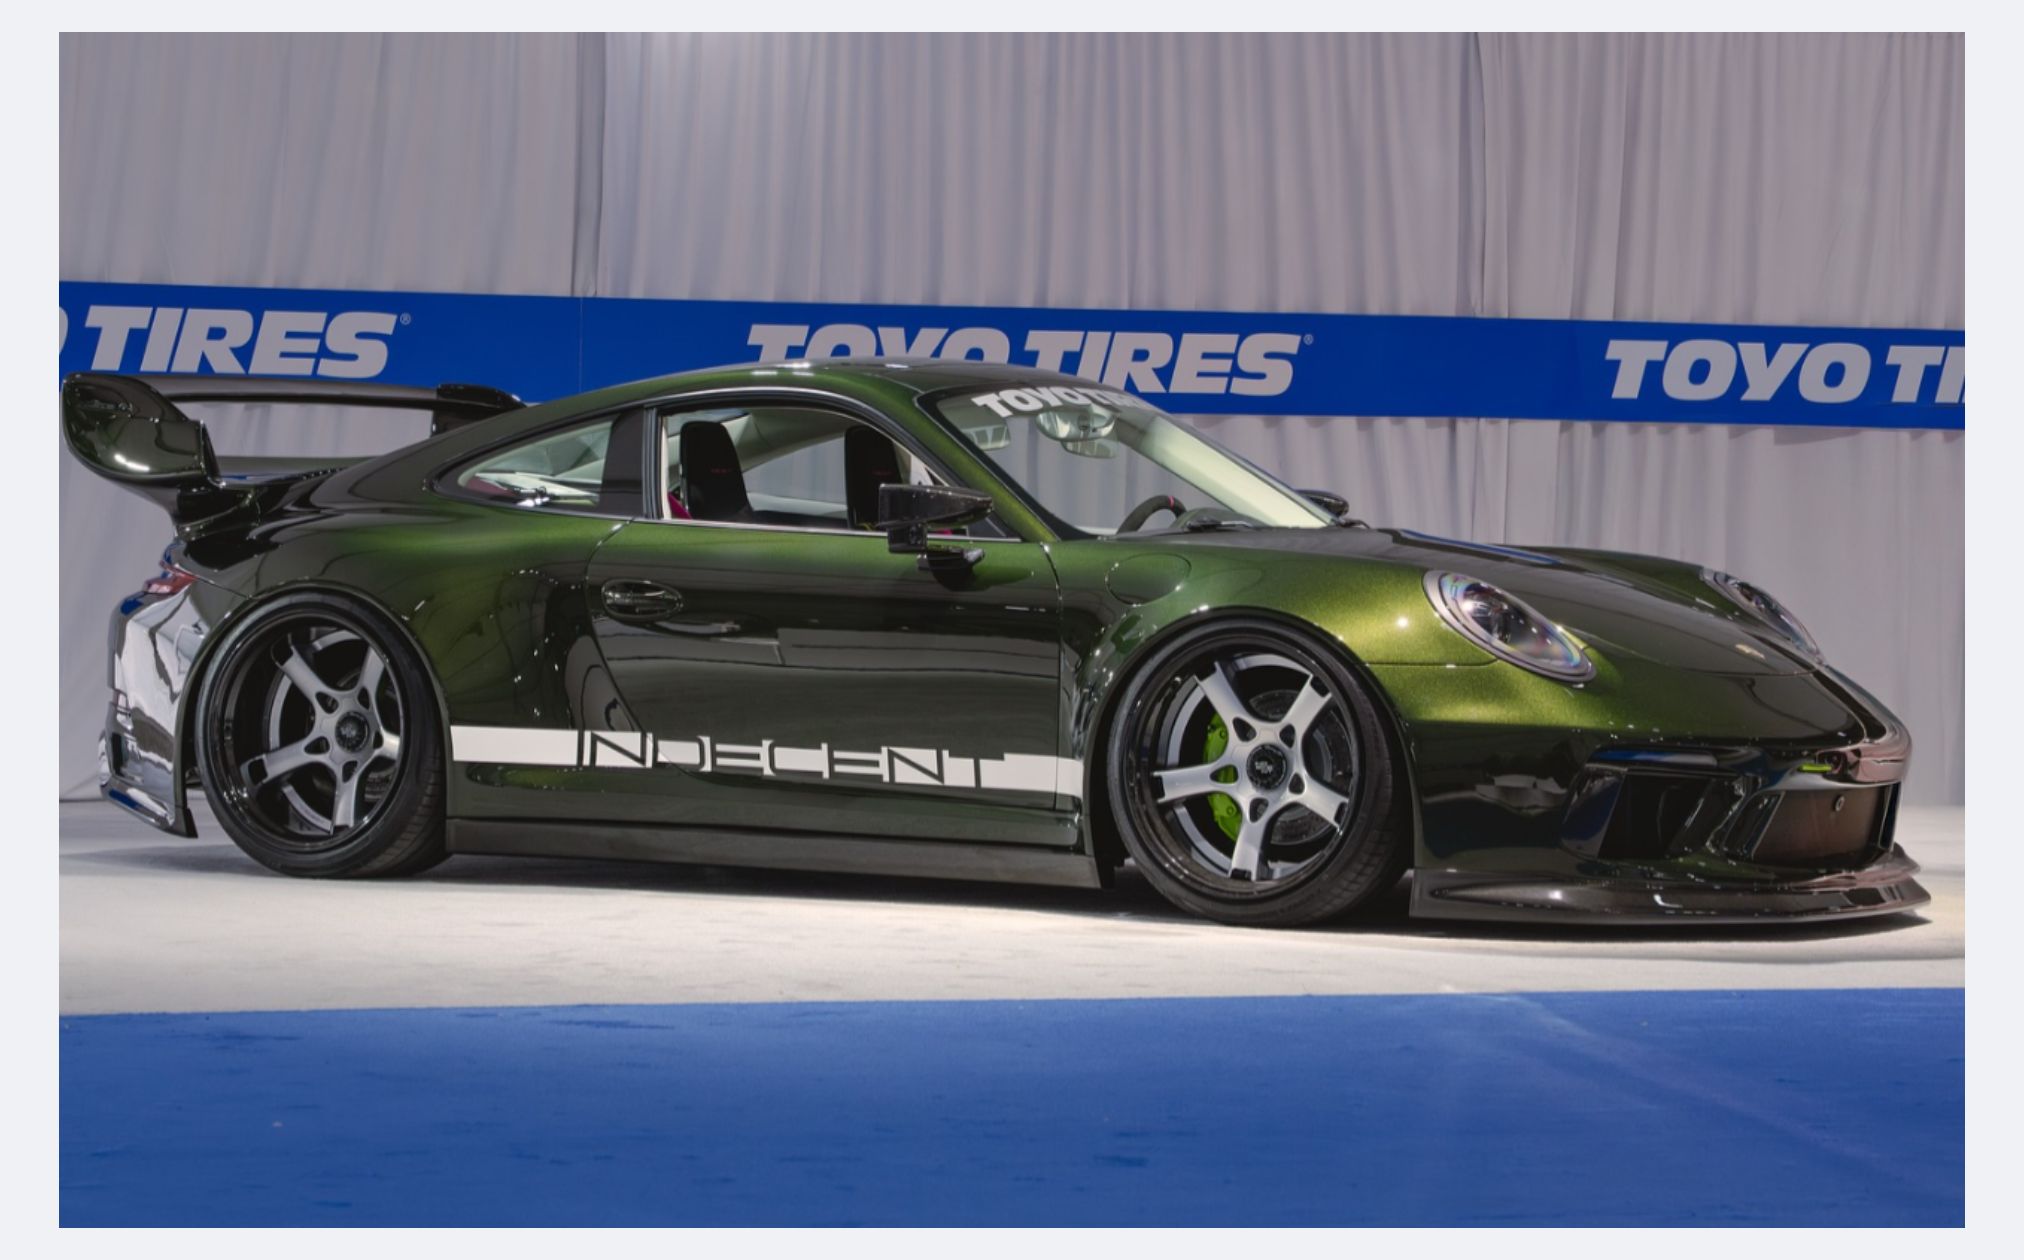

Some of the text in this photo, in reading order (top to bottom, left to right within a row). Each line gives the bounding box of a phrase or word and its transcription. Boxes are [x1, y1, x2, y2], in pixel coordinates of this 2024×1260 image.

[1605, 339, 1965, 403] TOYO TI
[971, 387, 1093, 418] TOYO
[577, 729, 1005, 788] INDECENT
